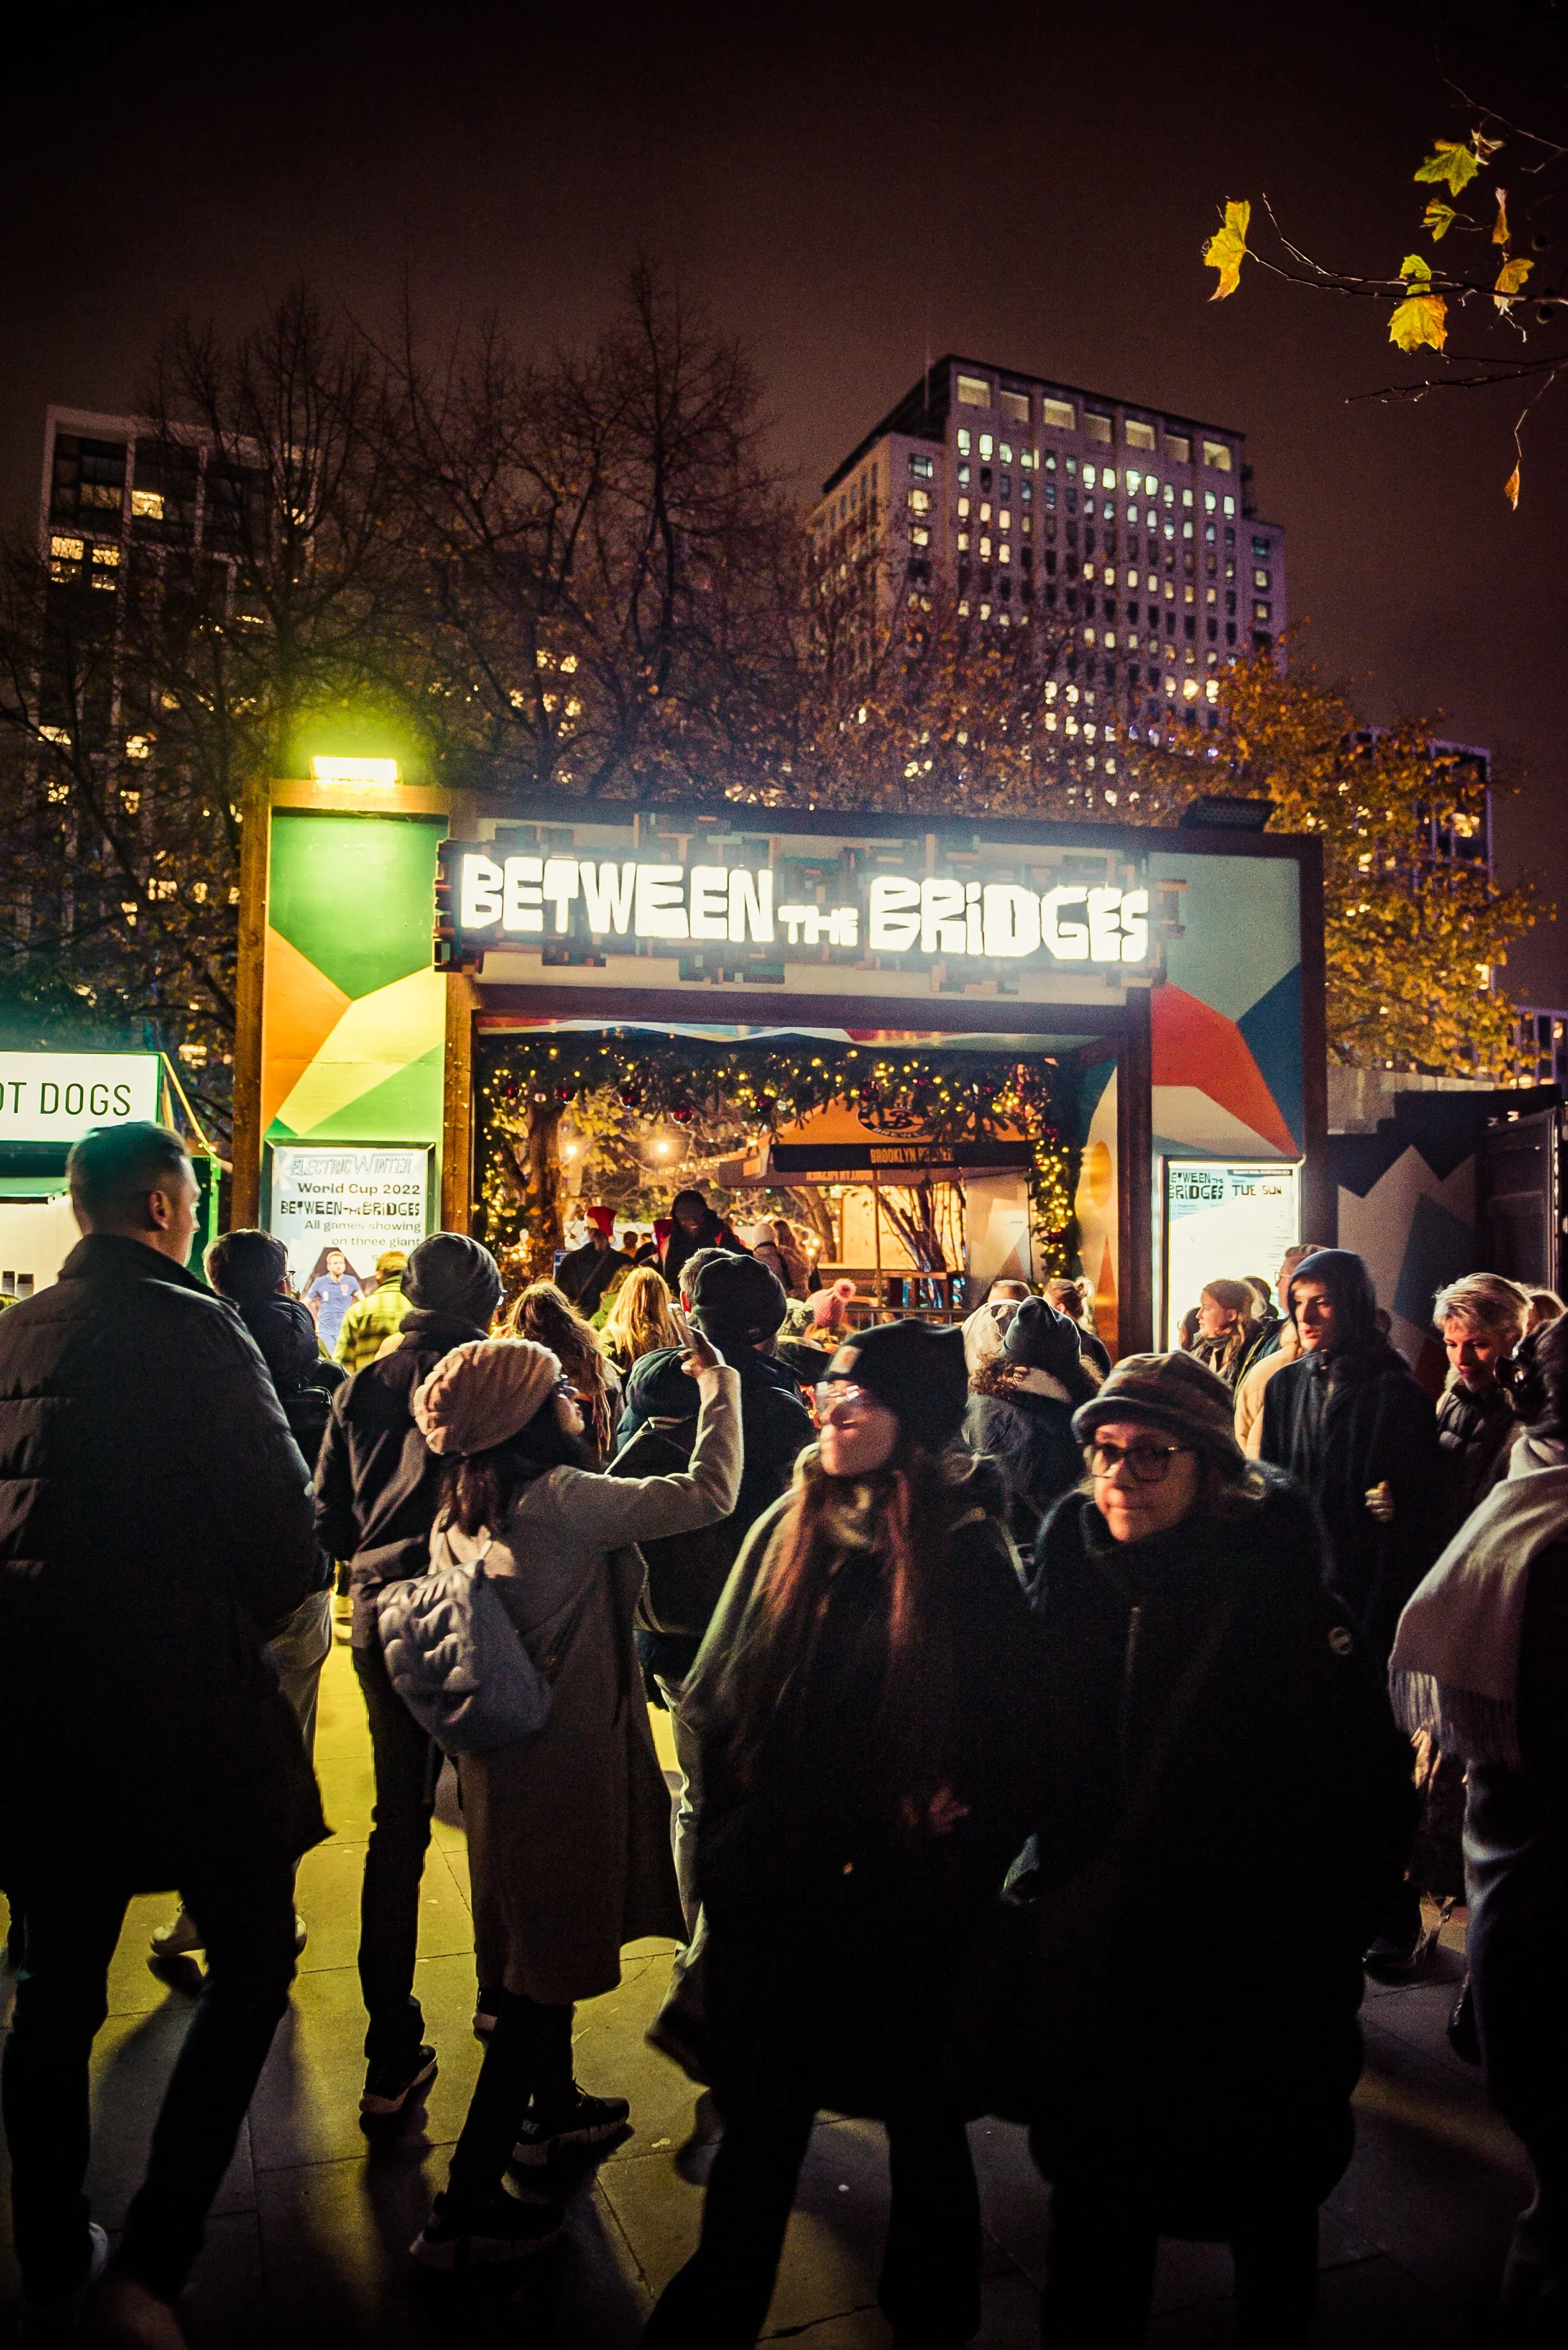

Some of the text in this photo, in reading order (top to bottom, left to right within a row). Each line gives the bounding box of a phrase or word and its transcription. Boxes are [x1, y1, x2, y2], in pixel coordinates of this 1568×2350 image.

[460, 853, 774, 942] BETWEEN
[778, 905, 859, 946] THE
[0, 1082, 132, 1116] T DOGS
[290, 1154, 412, 1176] ELECTRIC WINTER
[1171, 1172, 1211, 1183] ETWEEN
[298, 1183, 420, 1196] World Cup 2022
[1232, 1185, 1282, 1195] TUE SUN
[281, 1201, 342, 1215] BETWEEN
[304, 1220, 421, 1233] All games showing
[351, 1237, 386, 1245] three
[389, 1238, 421, 1248] giant
